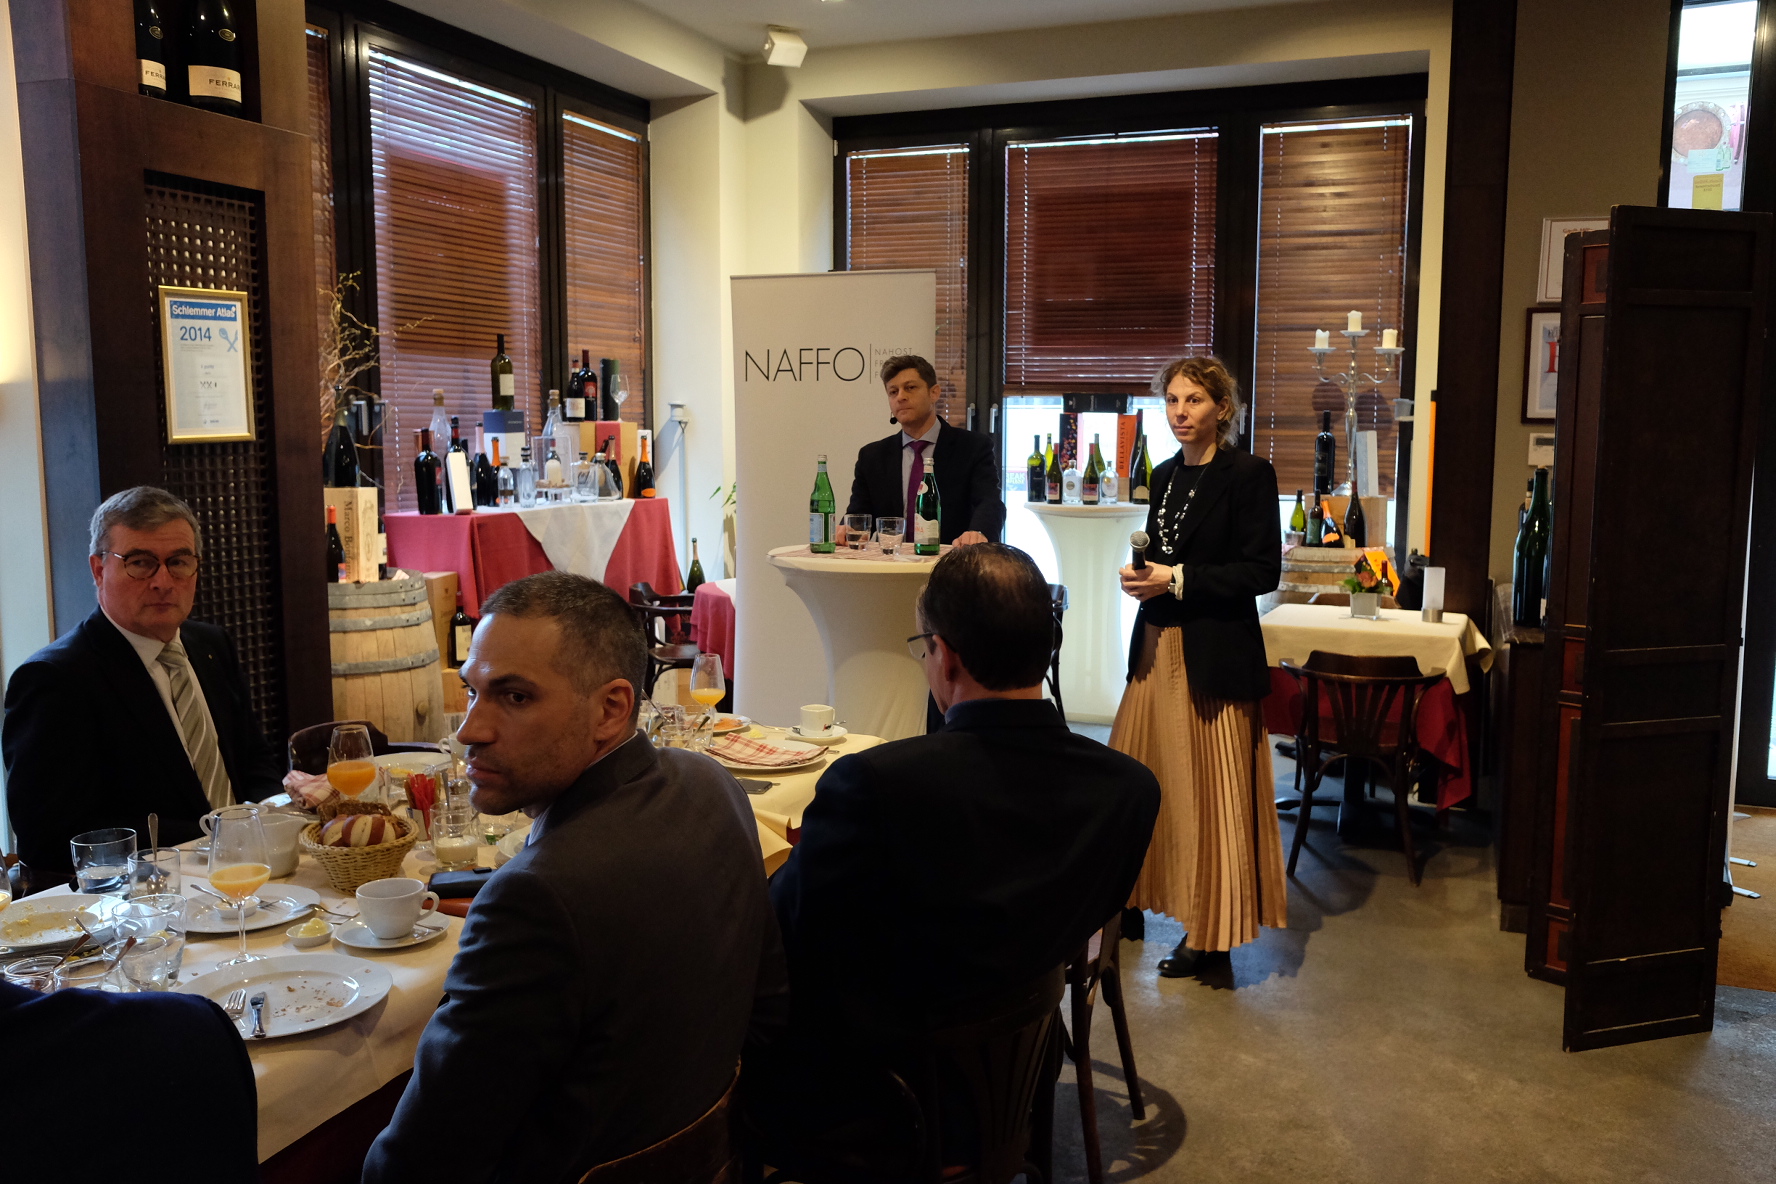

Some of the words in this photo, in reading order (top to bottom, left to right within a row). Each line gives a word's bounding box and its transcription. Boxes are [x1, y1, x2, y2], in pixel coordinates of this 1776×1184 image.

[172, 304, 215, 316] Schlemmer
[216, 306, 235, 318] Atlas
[180, 325, 212, 341] 2014
[874, 347, 913, 356] NAHOST
[745, 347, 865, 382] NAFFO
[344, 501, 353, 532] Marco
